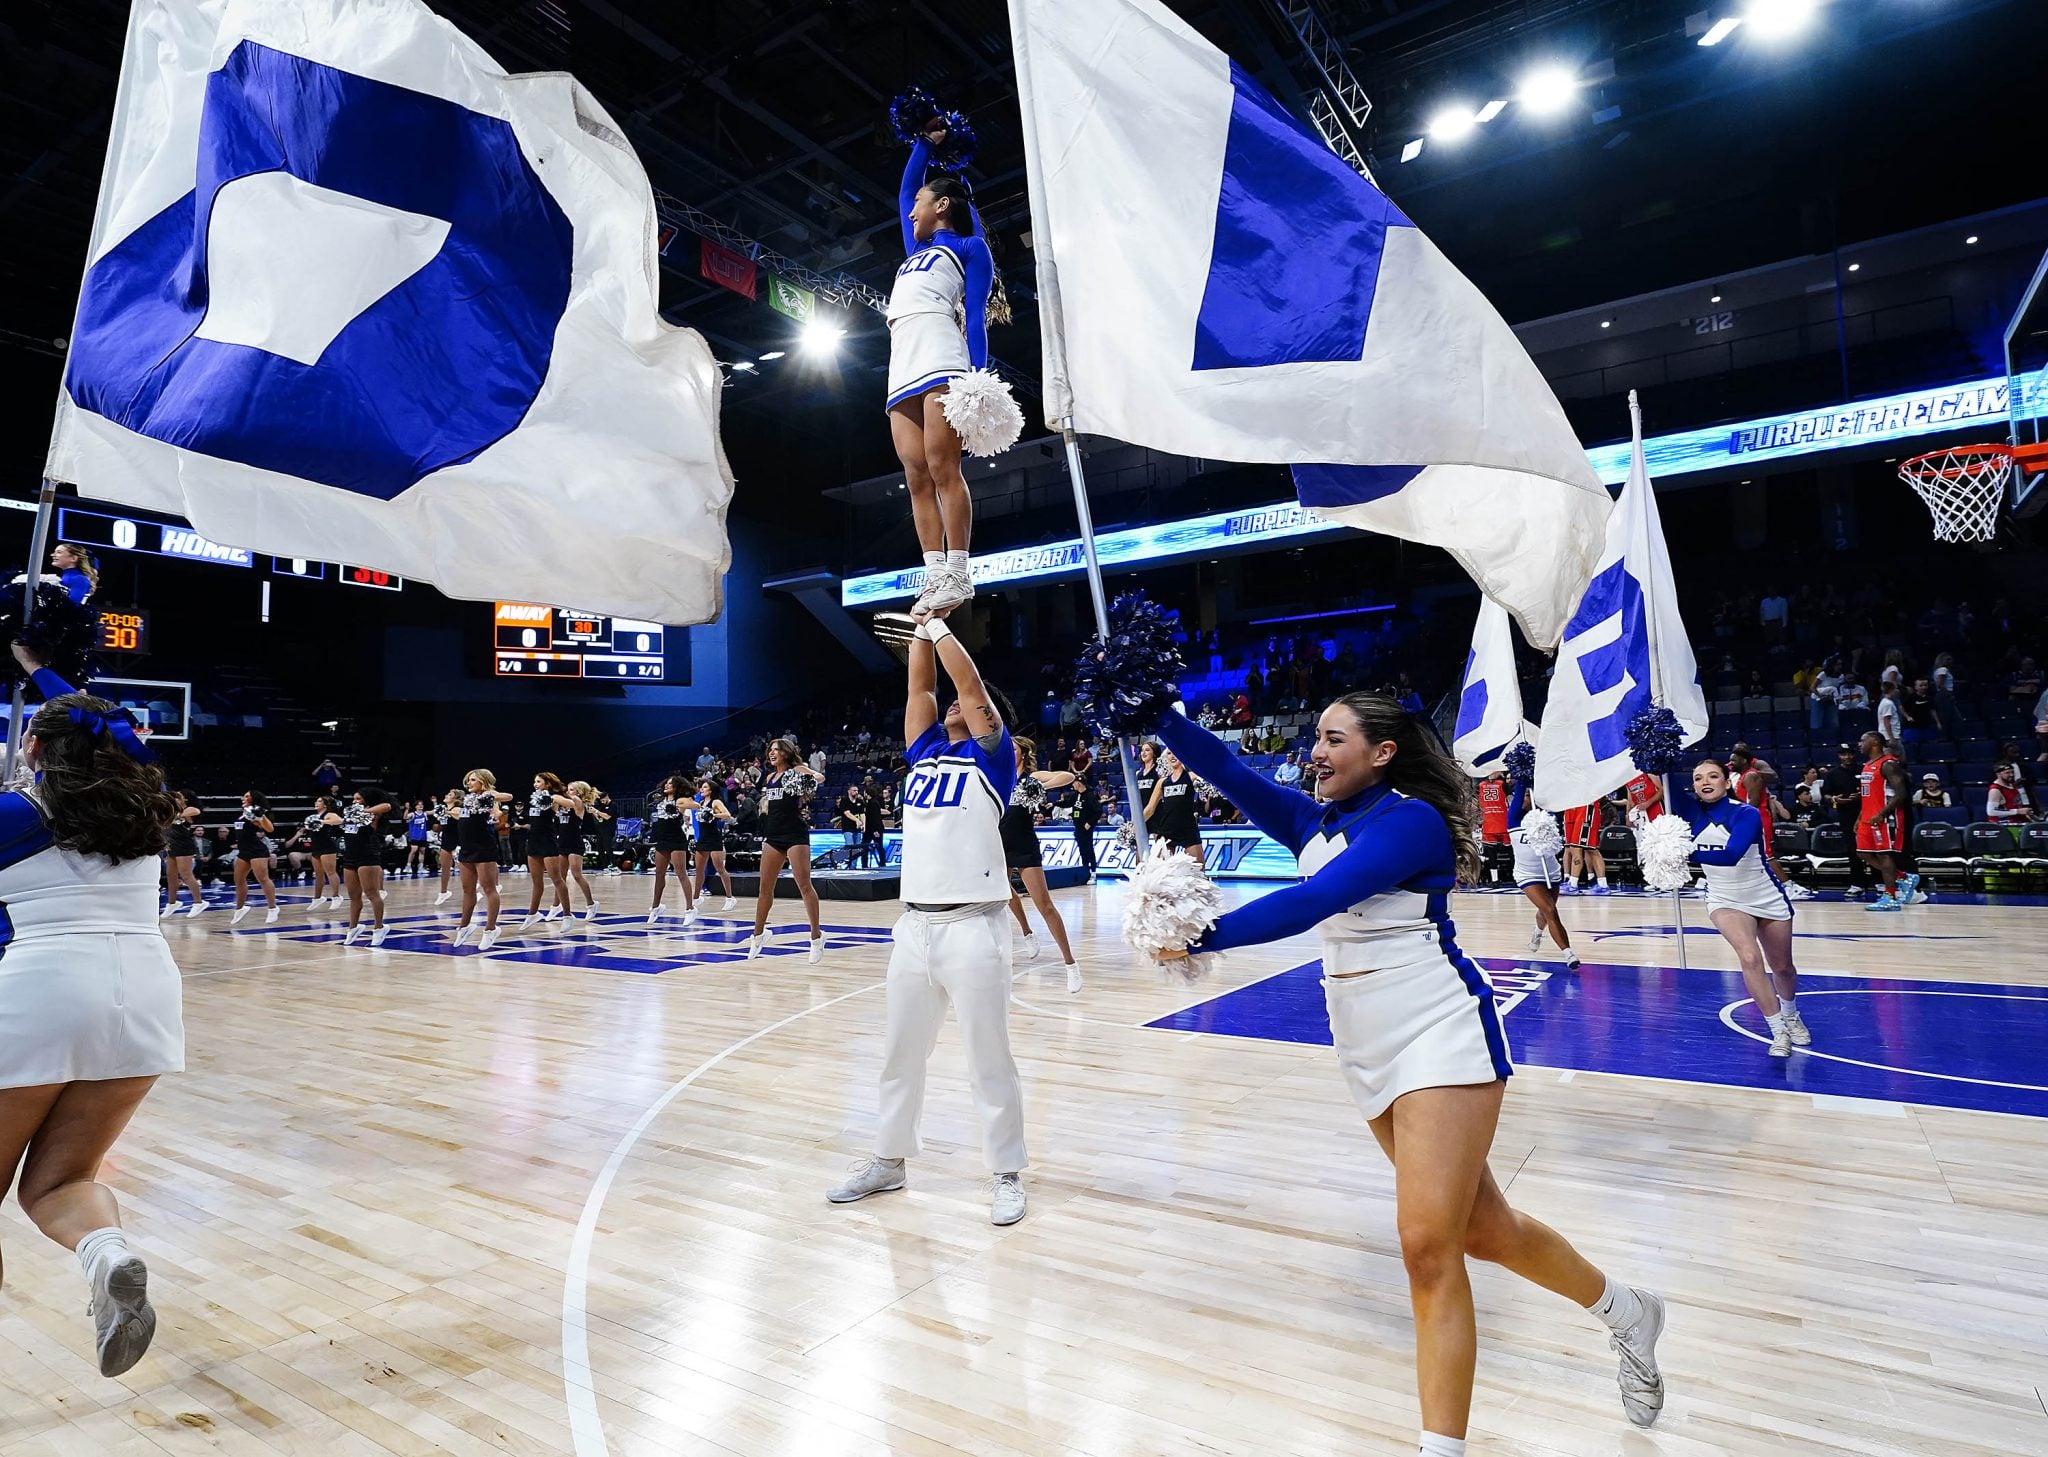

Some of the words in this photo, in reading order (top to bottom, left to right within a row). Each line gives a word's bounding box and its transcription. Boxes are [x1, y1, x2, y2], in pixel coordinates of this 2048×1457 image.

[1695, 311, 1734, 335] 212
[1729, 410, 1853, 455] PURPLE
[1224, 508, 1301, 537] PURPLE
[113, 519, 137, 550] 0
[160, 530, 250, 564] HOME
[1025, 544, 1084, 571] PARTY
[100, 612, 142, 628] 20:00
[496, 605, 551, 621] AWAY
[104, 626, 137, 649] 30
[522, 628, 537, 648] 0
[575, 621, 592, 633] 30
[636, 633, 650, 652] 0
[903, 772, 970, 809] GCU
[1483, 788, 1500, 801] 23
